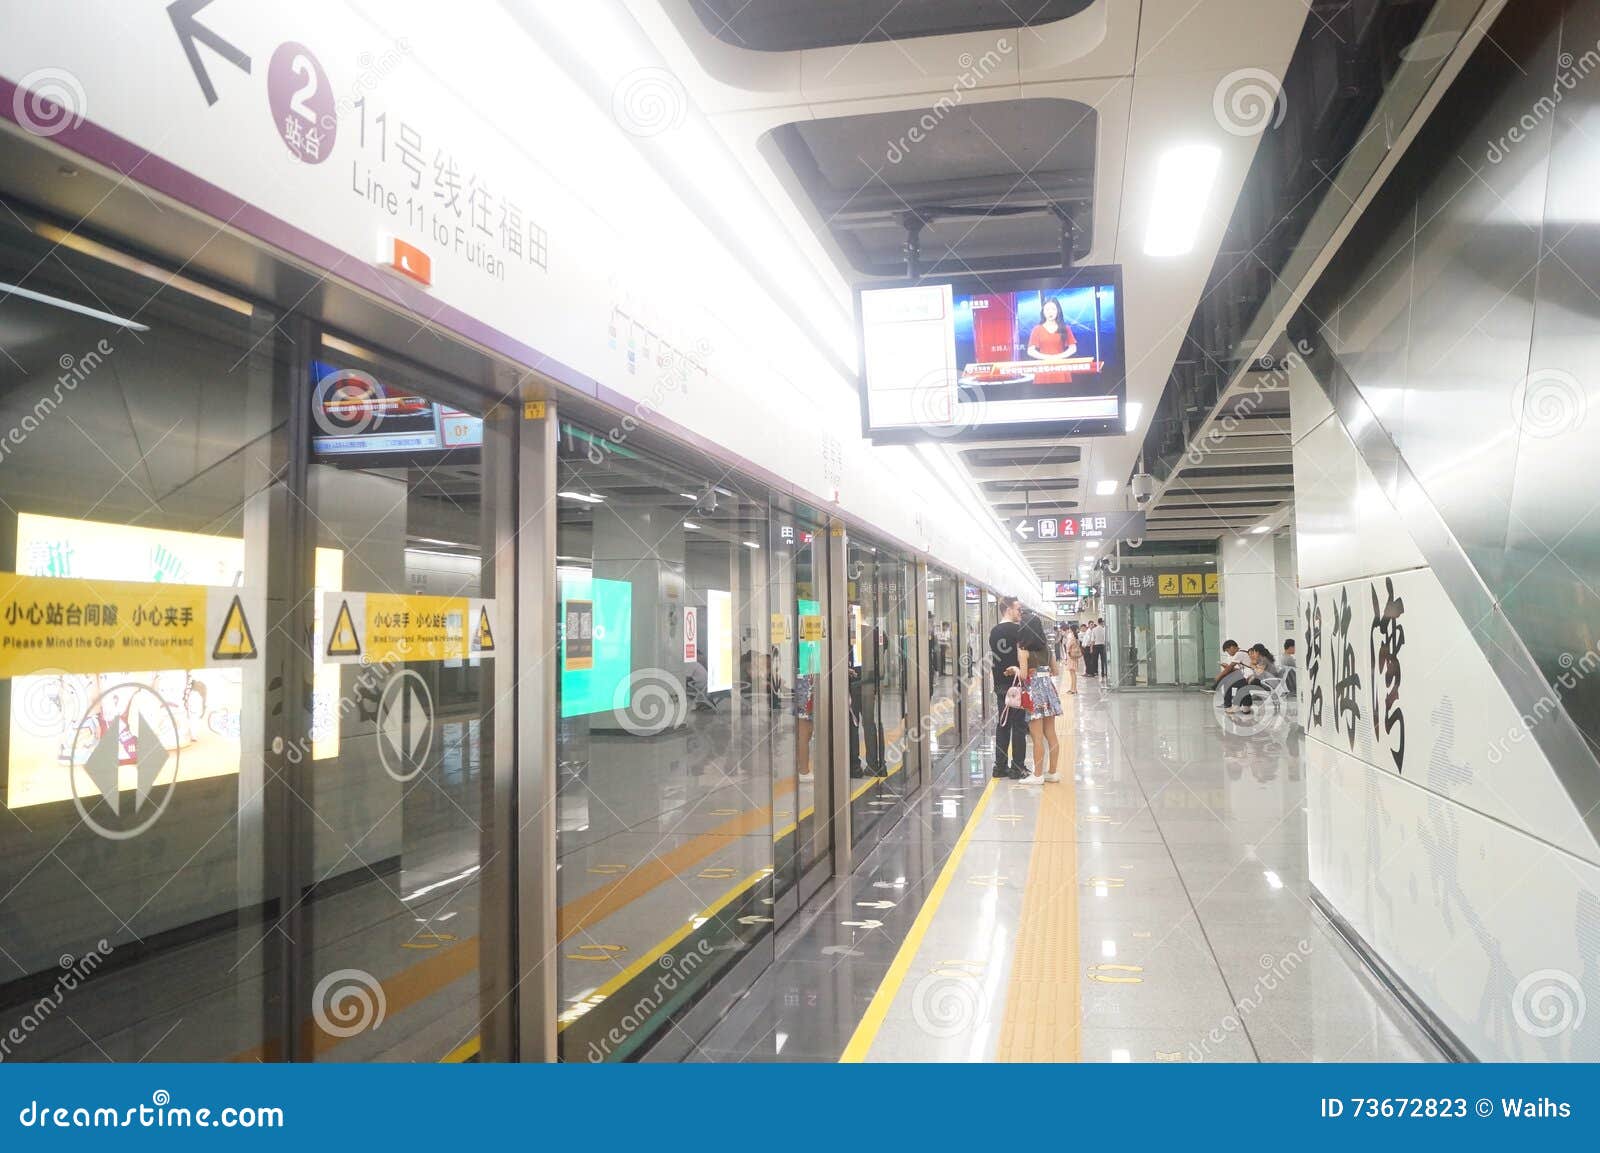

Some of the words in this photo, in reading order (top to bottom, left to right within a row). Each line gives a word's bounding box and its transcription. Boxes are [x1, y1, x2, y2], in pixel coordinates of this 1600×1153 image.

[290, 54, 318, 124] 2
[285, 114, 327, 160] 站台
[353, 160, 398, 215] Line
[406, 197, 424, 233] 11
[432, 214, 449, 246] to
[455, 226, 504, 281] Futian
[1065, 519, 1073, 530] 2
[1129, 576, 1155, 588] 电梯
[5, 601, 119, 627] 小心站台间隙
[132, 605, 194, 628] 小心夹手
[3, 636, 42, 649] Please
[45, 636, 73, 649] Mind
[75, 636, 93, 648] the
[95, 637, 115, 651] Gap
[122, 636, 147, 648] Mind
[150, 637, 170, 648] Your
[171, 637, 194, 648] Hand
